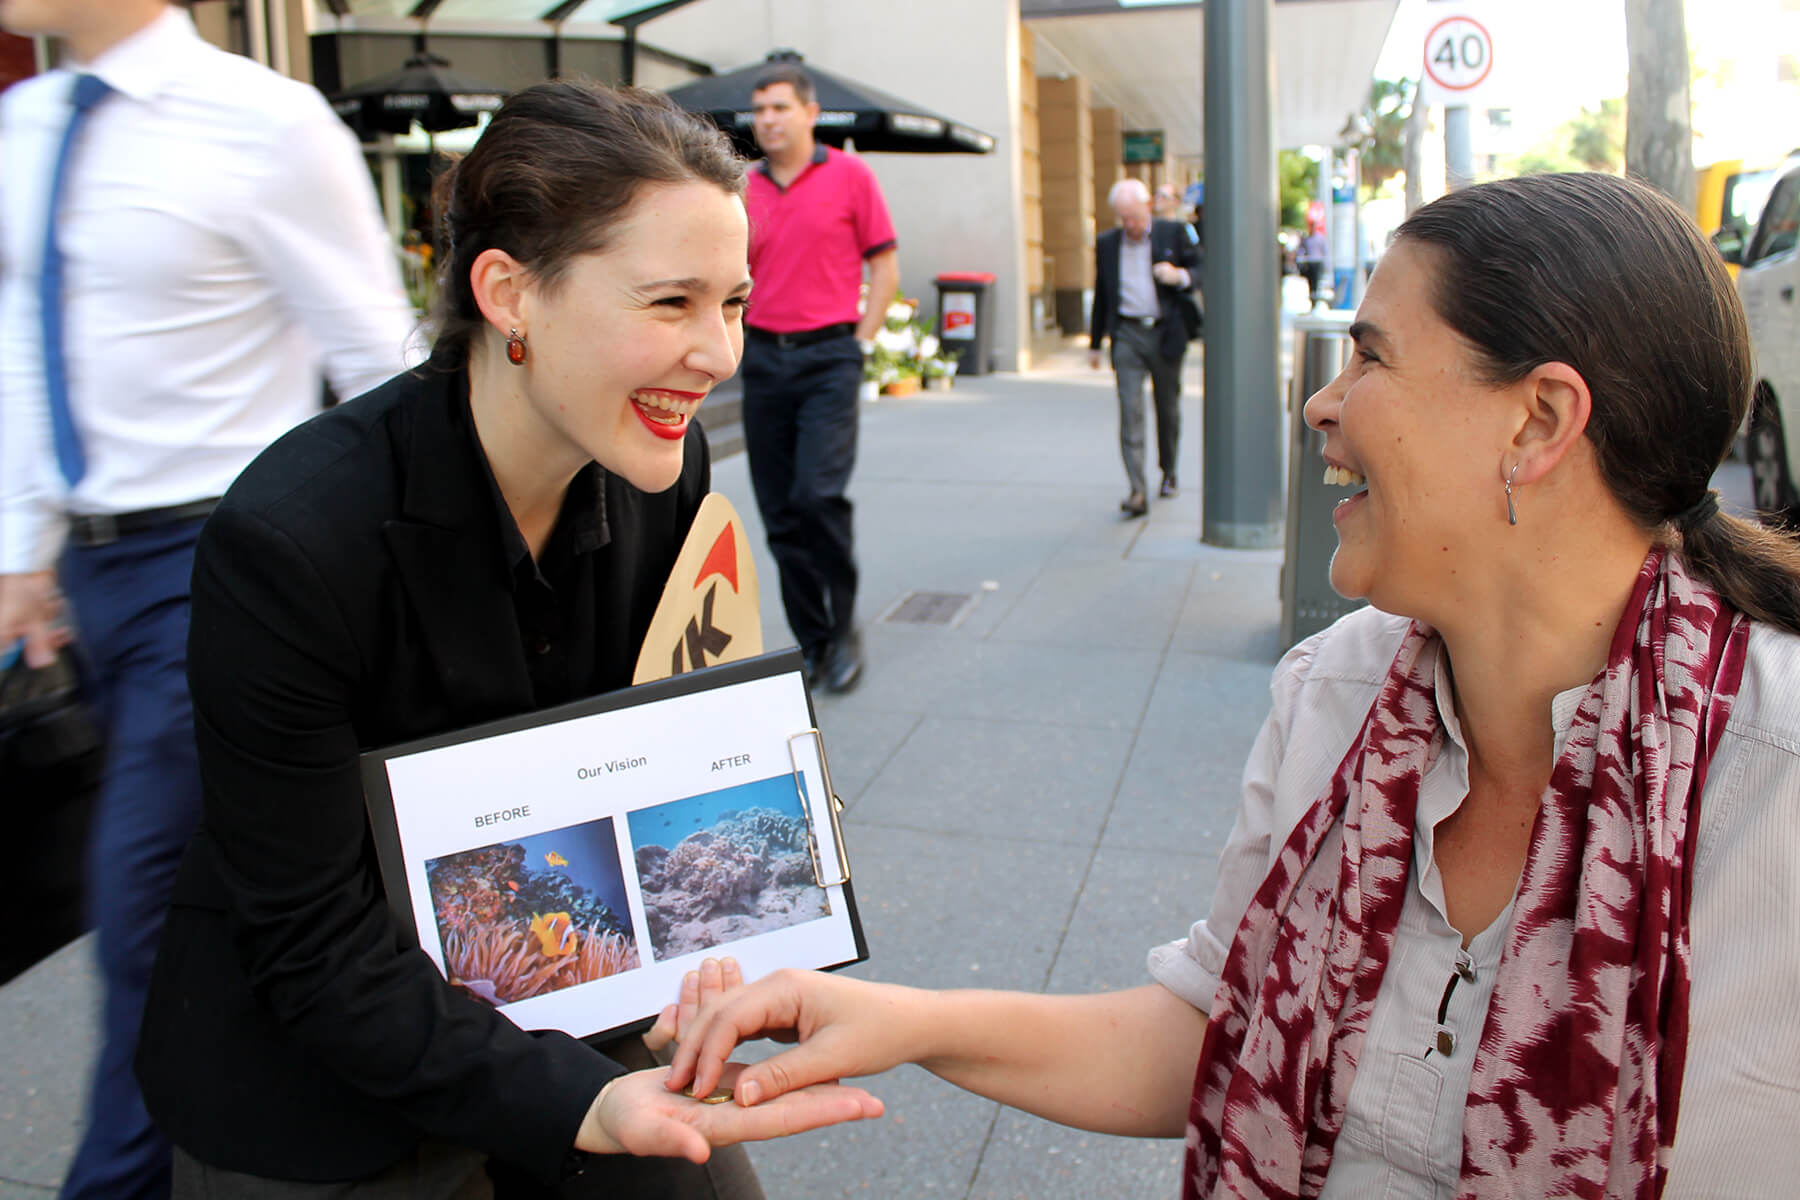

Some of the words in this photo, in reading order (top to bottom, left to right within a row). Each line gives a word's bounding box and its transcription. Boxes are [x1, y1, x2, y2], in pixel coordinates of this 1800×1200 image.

[1434, 34, 1484, 70] 40
[577, 767, 602, 780] Our
[604, 756, 648, 773] Vision
[711, 753, 752, 772] AFTER
[474, 804, 532, 828] BEFORE
